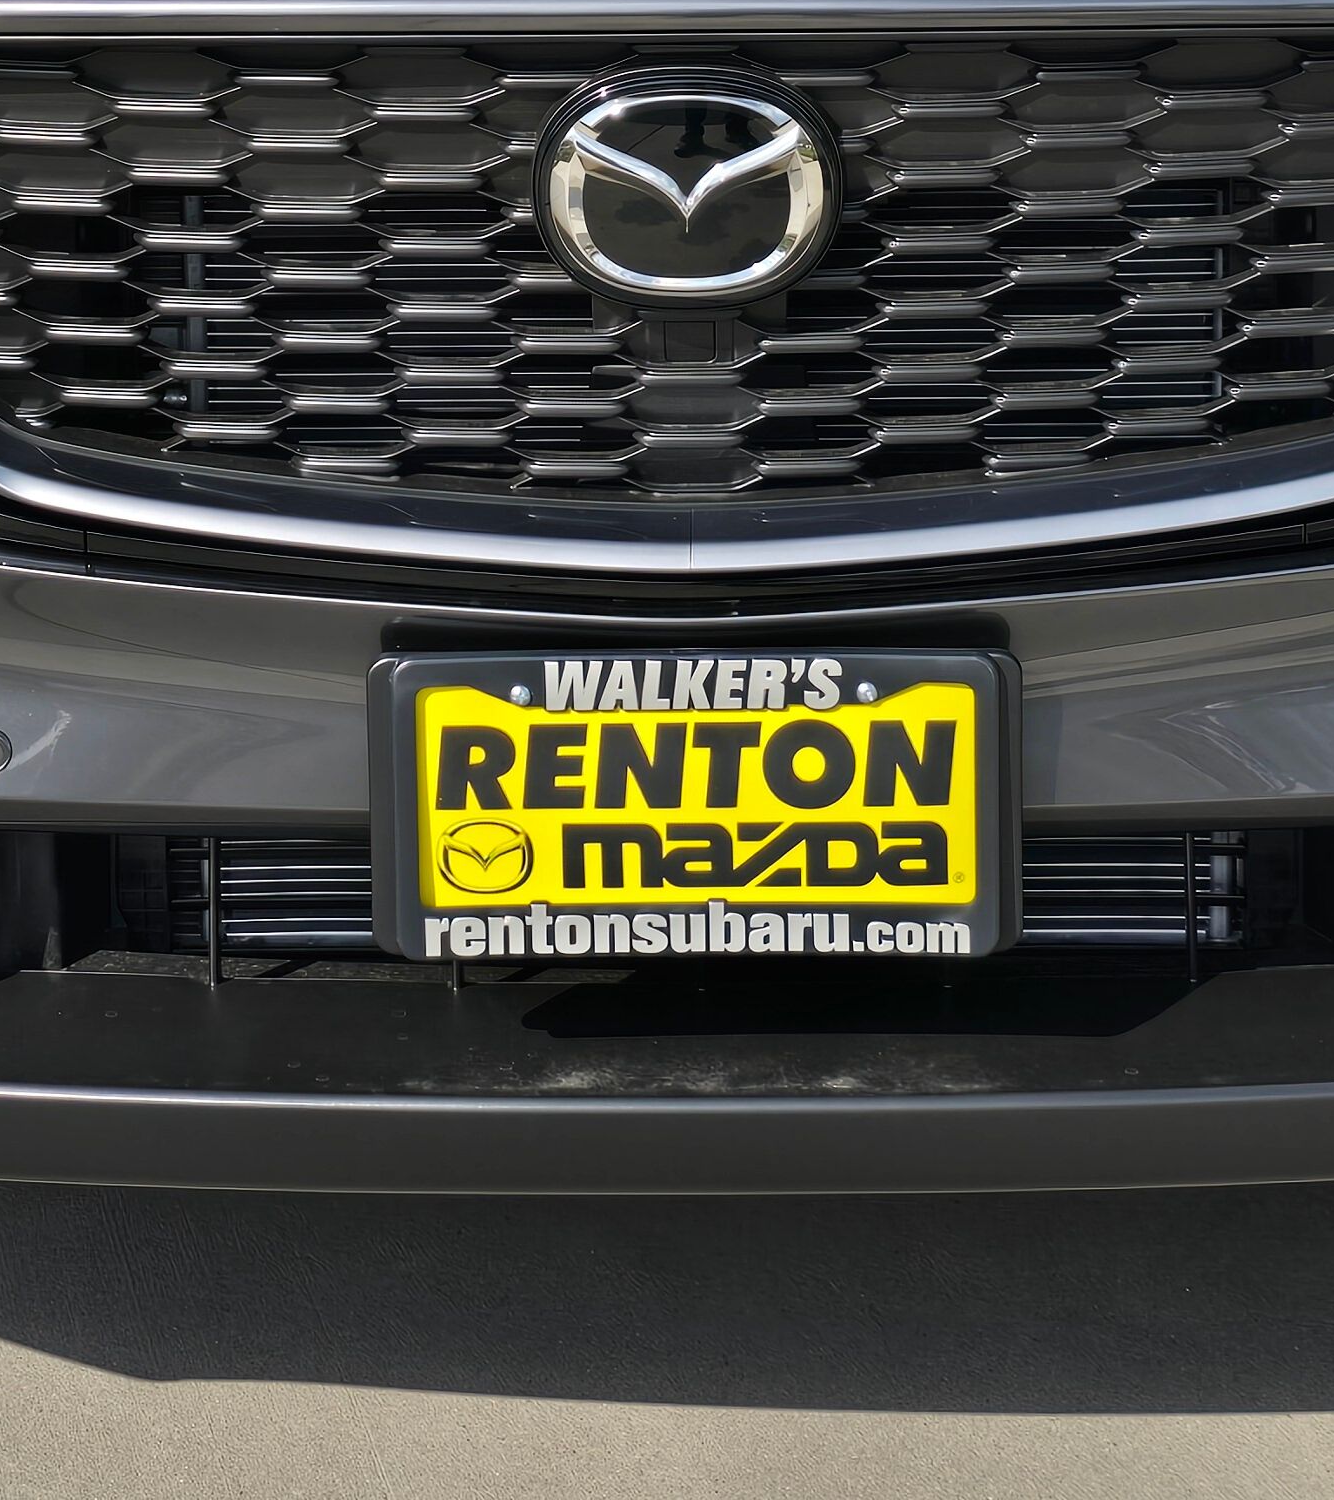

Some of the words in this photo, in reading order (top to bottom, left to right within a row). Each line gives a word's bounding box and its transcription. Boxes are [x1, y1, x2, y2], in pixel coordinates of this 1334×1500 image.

[544, 659, 843, 711] WALKER'S
[435, 719, 957, 810] RENTON
[424, 901, 971, 957] rentonsubaru.com
